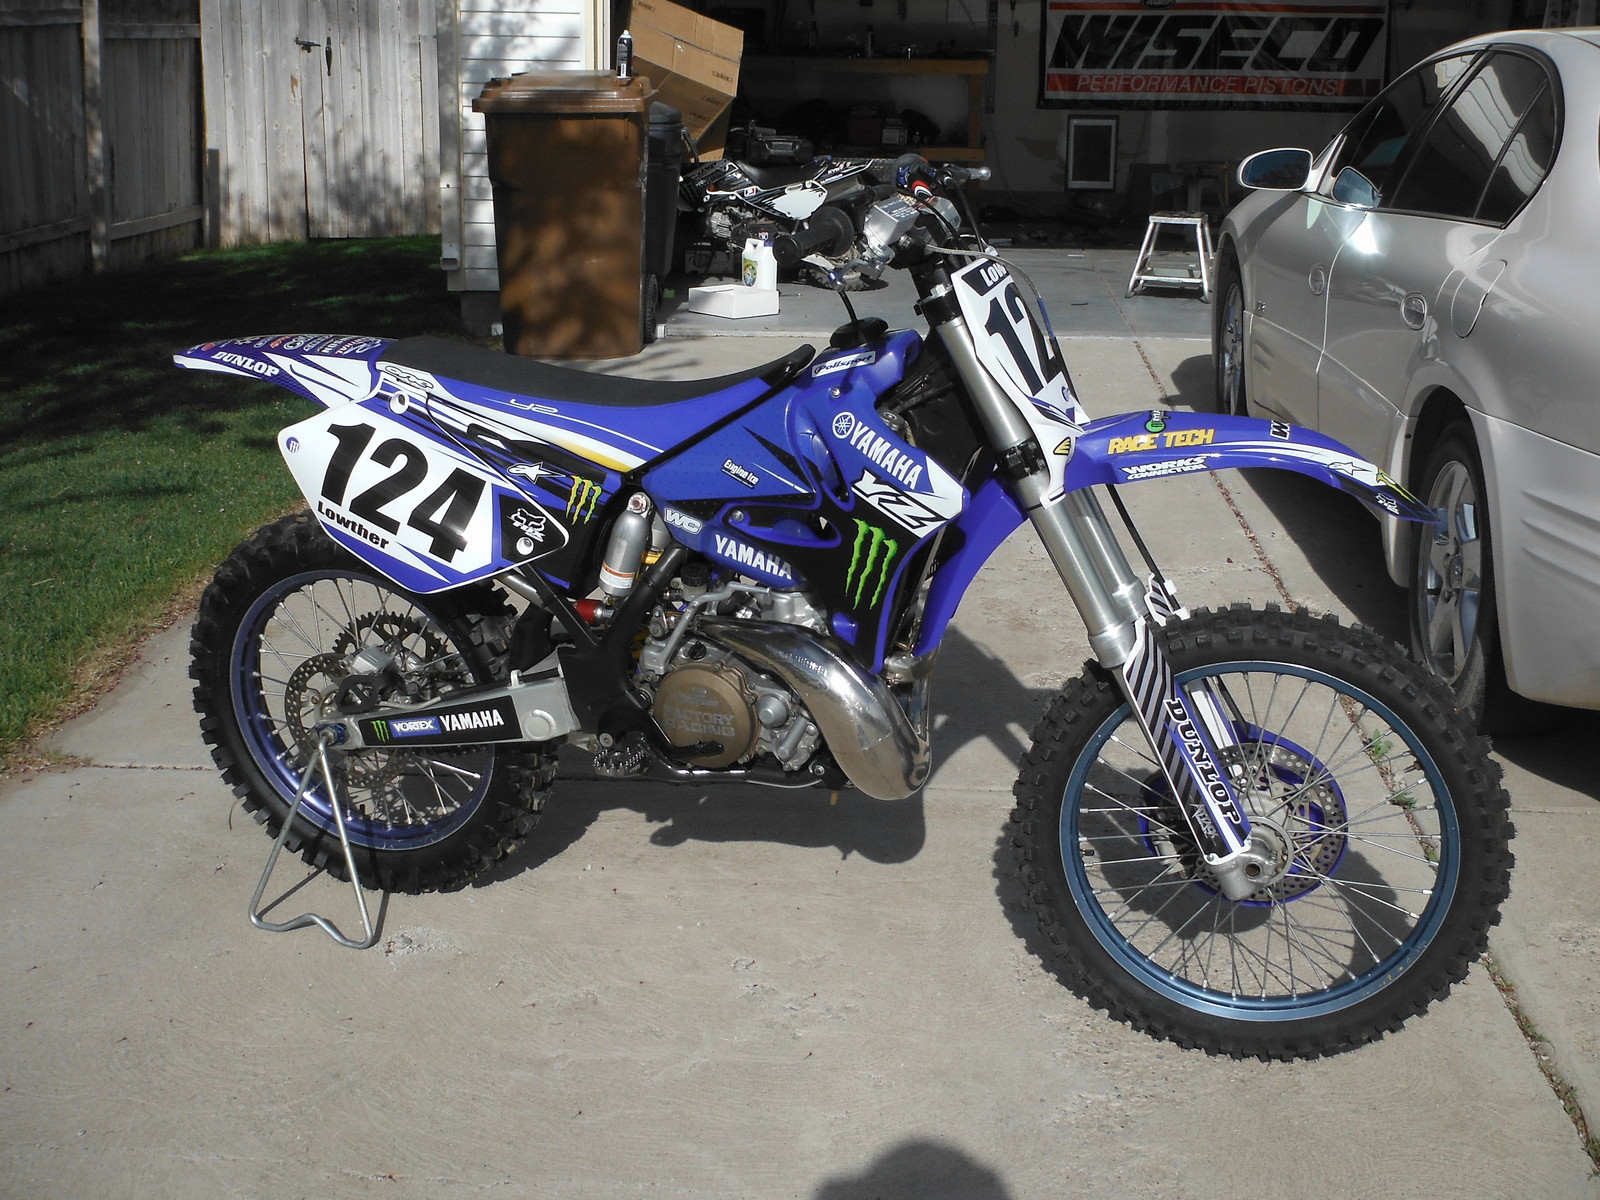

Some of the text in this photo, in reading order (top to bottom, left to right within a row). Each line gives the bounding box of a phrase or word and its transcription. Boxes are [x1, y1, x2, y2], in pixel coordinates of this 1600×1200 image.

[1048, 14, 1385, 72] WISECO
[1077, 74, 1341, 96] PERFORMANCE PISTONS
[210, 351, 280, 378] DUNLOP
[814, 354, 873, 375] Polisport
[1107, 428, 1215, 455] RACE TECH
[850, 421, 923, 490] YAMAHA
[1120, 456, 1209, 475] WORKS
[723, 458, 760, 485] Engine Ice
[1126, 463, 1209, 481] CONNECTION
[320, 422, 487, 564] 124
[317, 500, 390, 551] Lowther
[714, 534, 793, 581] YAMAHA
[391, 708, 505, 735] VORTEX YAMAHA
[663, 705, 734, 726] FACTORY
[663, 719, 736, 737] RACING
[1163, 697, 1242, 825] DUNLOP
